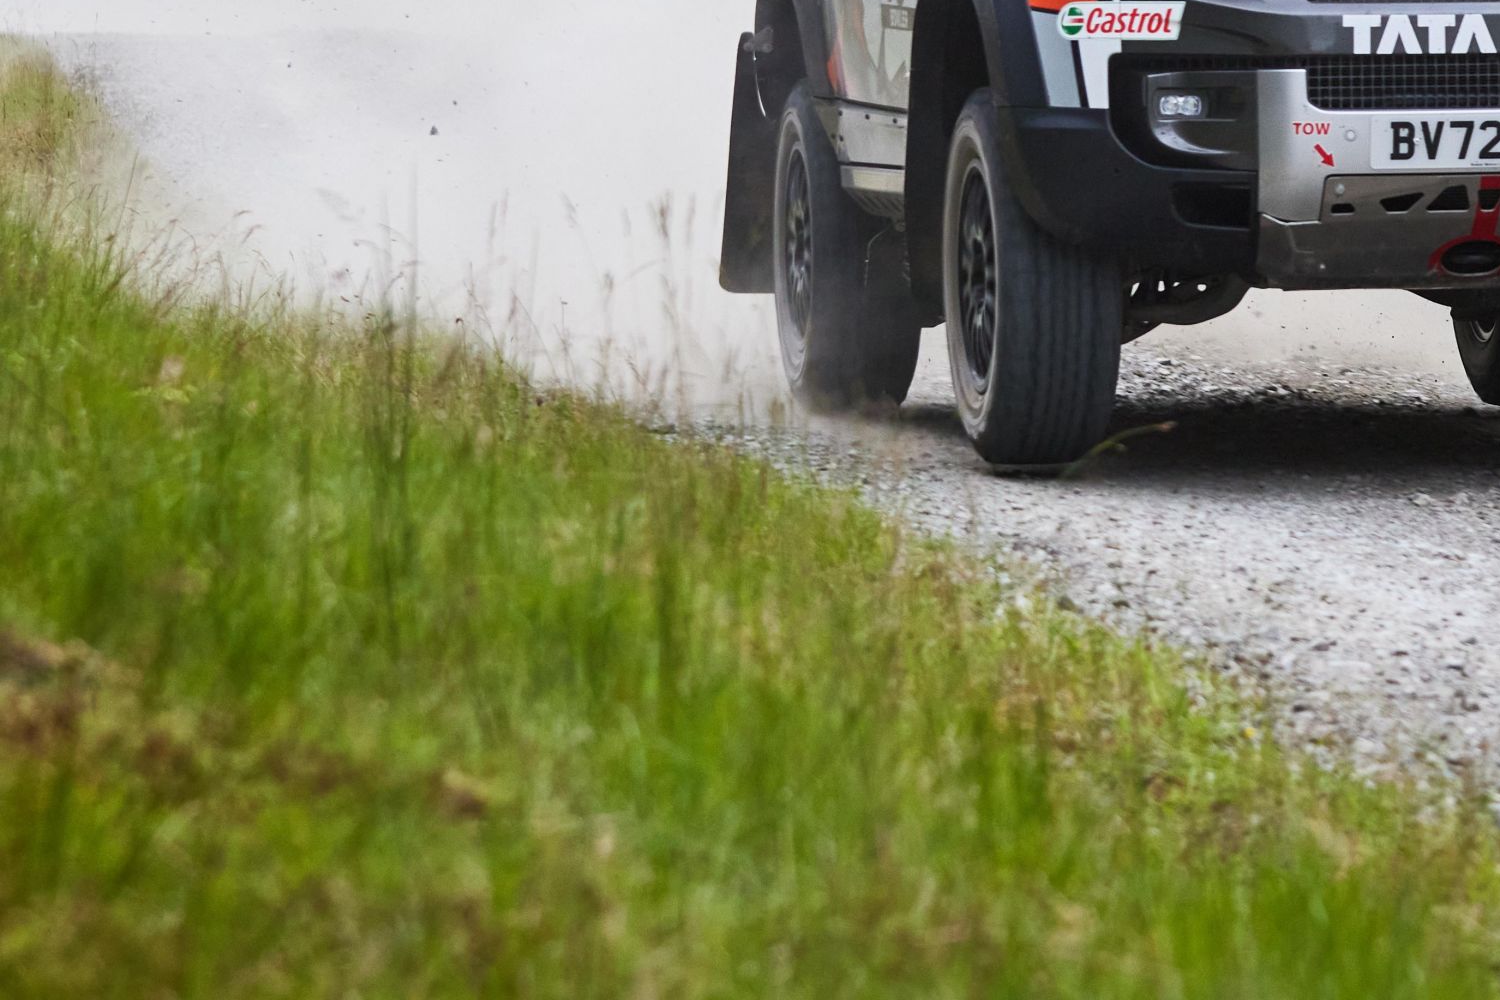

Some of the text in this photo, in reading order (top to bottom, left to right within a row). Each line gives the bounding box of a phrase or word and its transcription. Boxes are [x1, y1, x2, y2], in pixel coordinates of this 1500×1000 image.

[1086, 7, 1172, 34] Castrol
[1342, 14, 1497, 55] TATA
[1292, 122, 1331, 136] TOW
